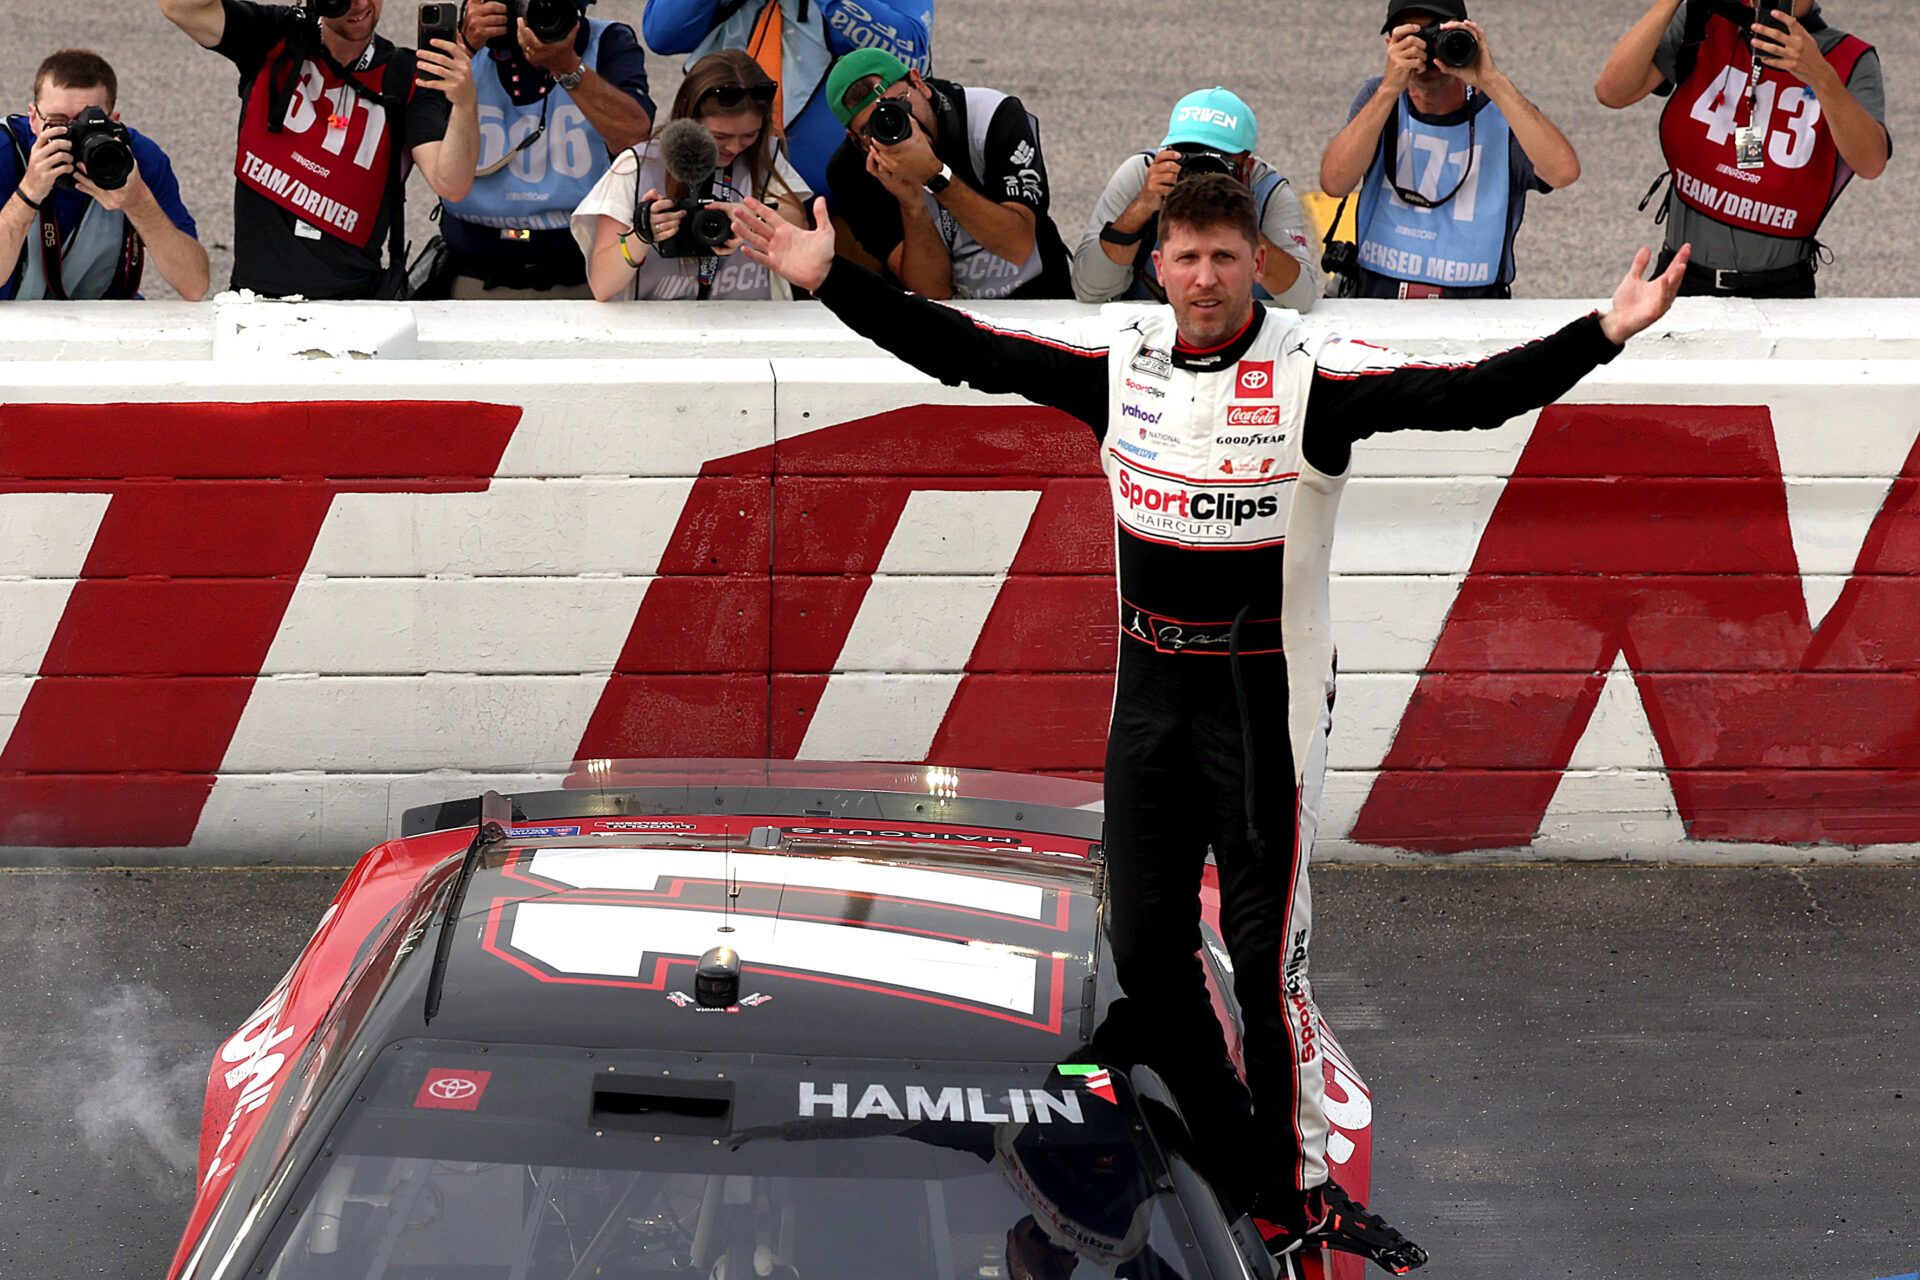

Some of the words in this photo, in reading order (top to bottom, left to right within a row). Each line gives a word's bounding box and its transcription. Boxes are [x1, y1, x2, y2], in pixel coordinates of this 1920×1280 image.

[283, 59, 387, 171] 311
[1177, 106, 1239, 130] DRIVEN
[1690, 65, 1821, 169] 413
[476, 104, 593, 183] 506
[293, 152, 331, 179] NASCAR
[1382, 128, 1483, 222] 471
[1720, 164, 1762, 184] NASCAR
[241, 151, 359, 233] TEAM/DRIVER
[1676, 168, 1798, 230] TEAM/DRIVER
[43, 222, 56, 247] EOS
[1426, 257, 1489, 282] MEDIA
[1121, 402, 1163, 425] yahoo!
[1148, 431, 1181, 445] NATIONAL
[1216, 433, 1286, 447] GOODYEAR
[1119, 469, 1278, 526] SportClips
[1136, 511, 1228, 536] HAIRCUTS
[799, 1081, 1085, 1124] HAMLIN
